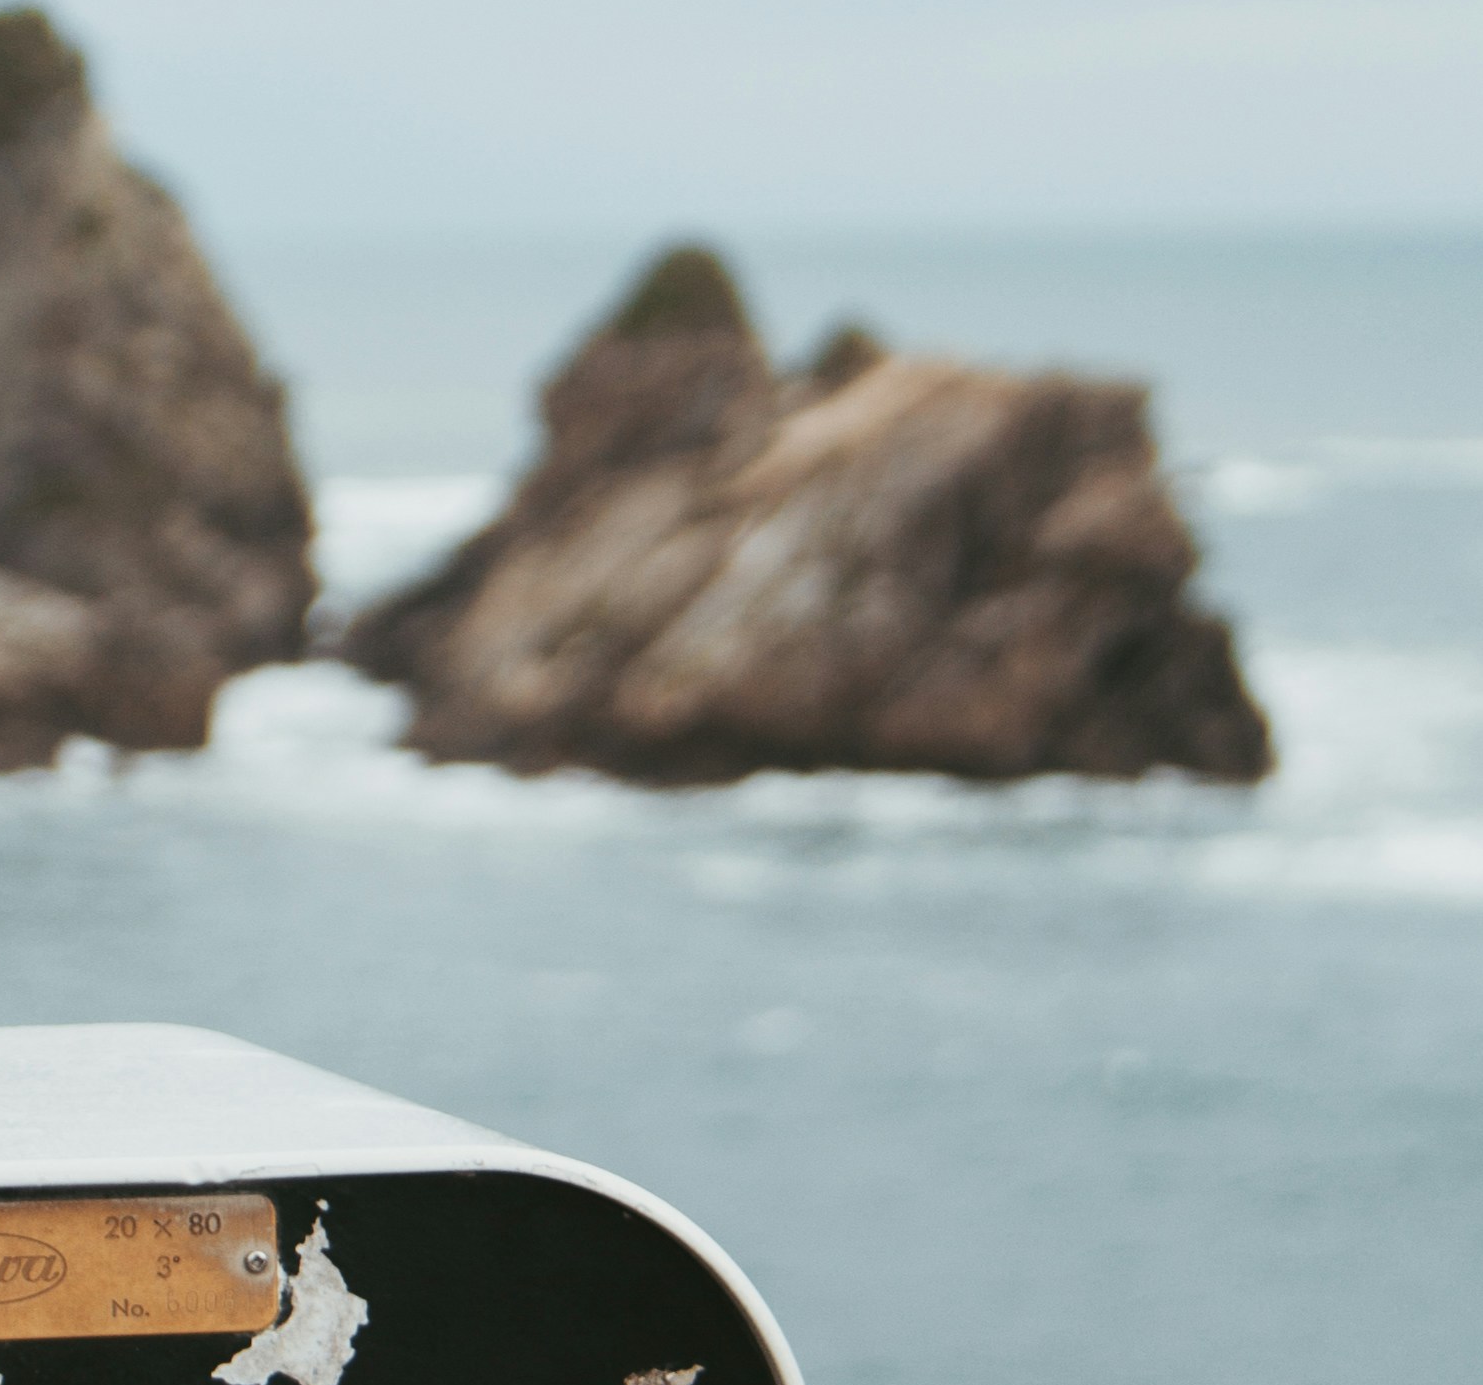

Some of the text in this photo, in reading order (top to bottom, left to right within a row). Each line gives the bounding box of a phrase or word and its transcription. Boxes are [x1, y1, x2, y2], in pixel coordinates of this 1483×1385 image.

[104, 1215, 137, 1239] 20
[188, 1212, 221, 1235] 80
[157, 1255, 181, 1278] 3°
[111, 1298, 150, 1318] No.
